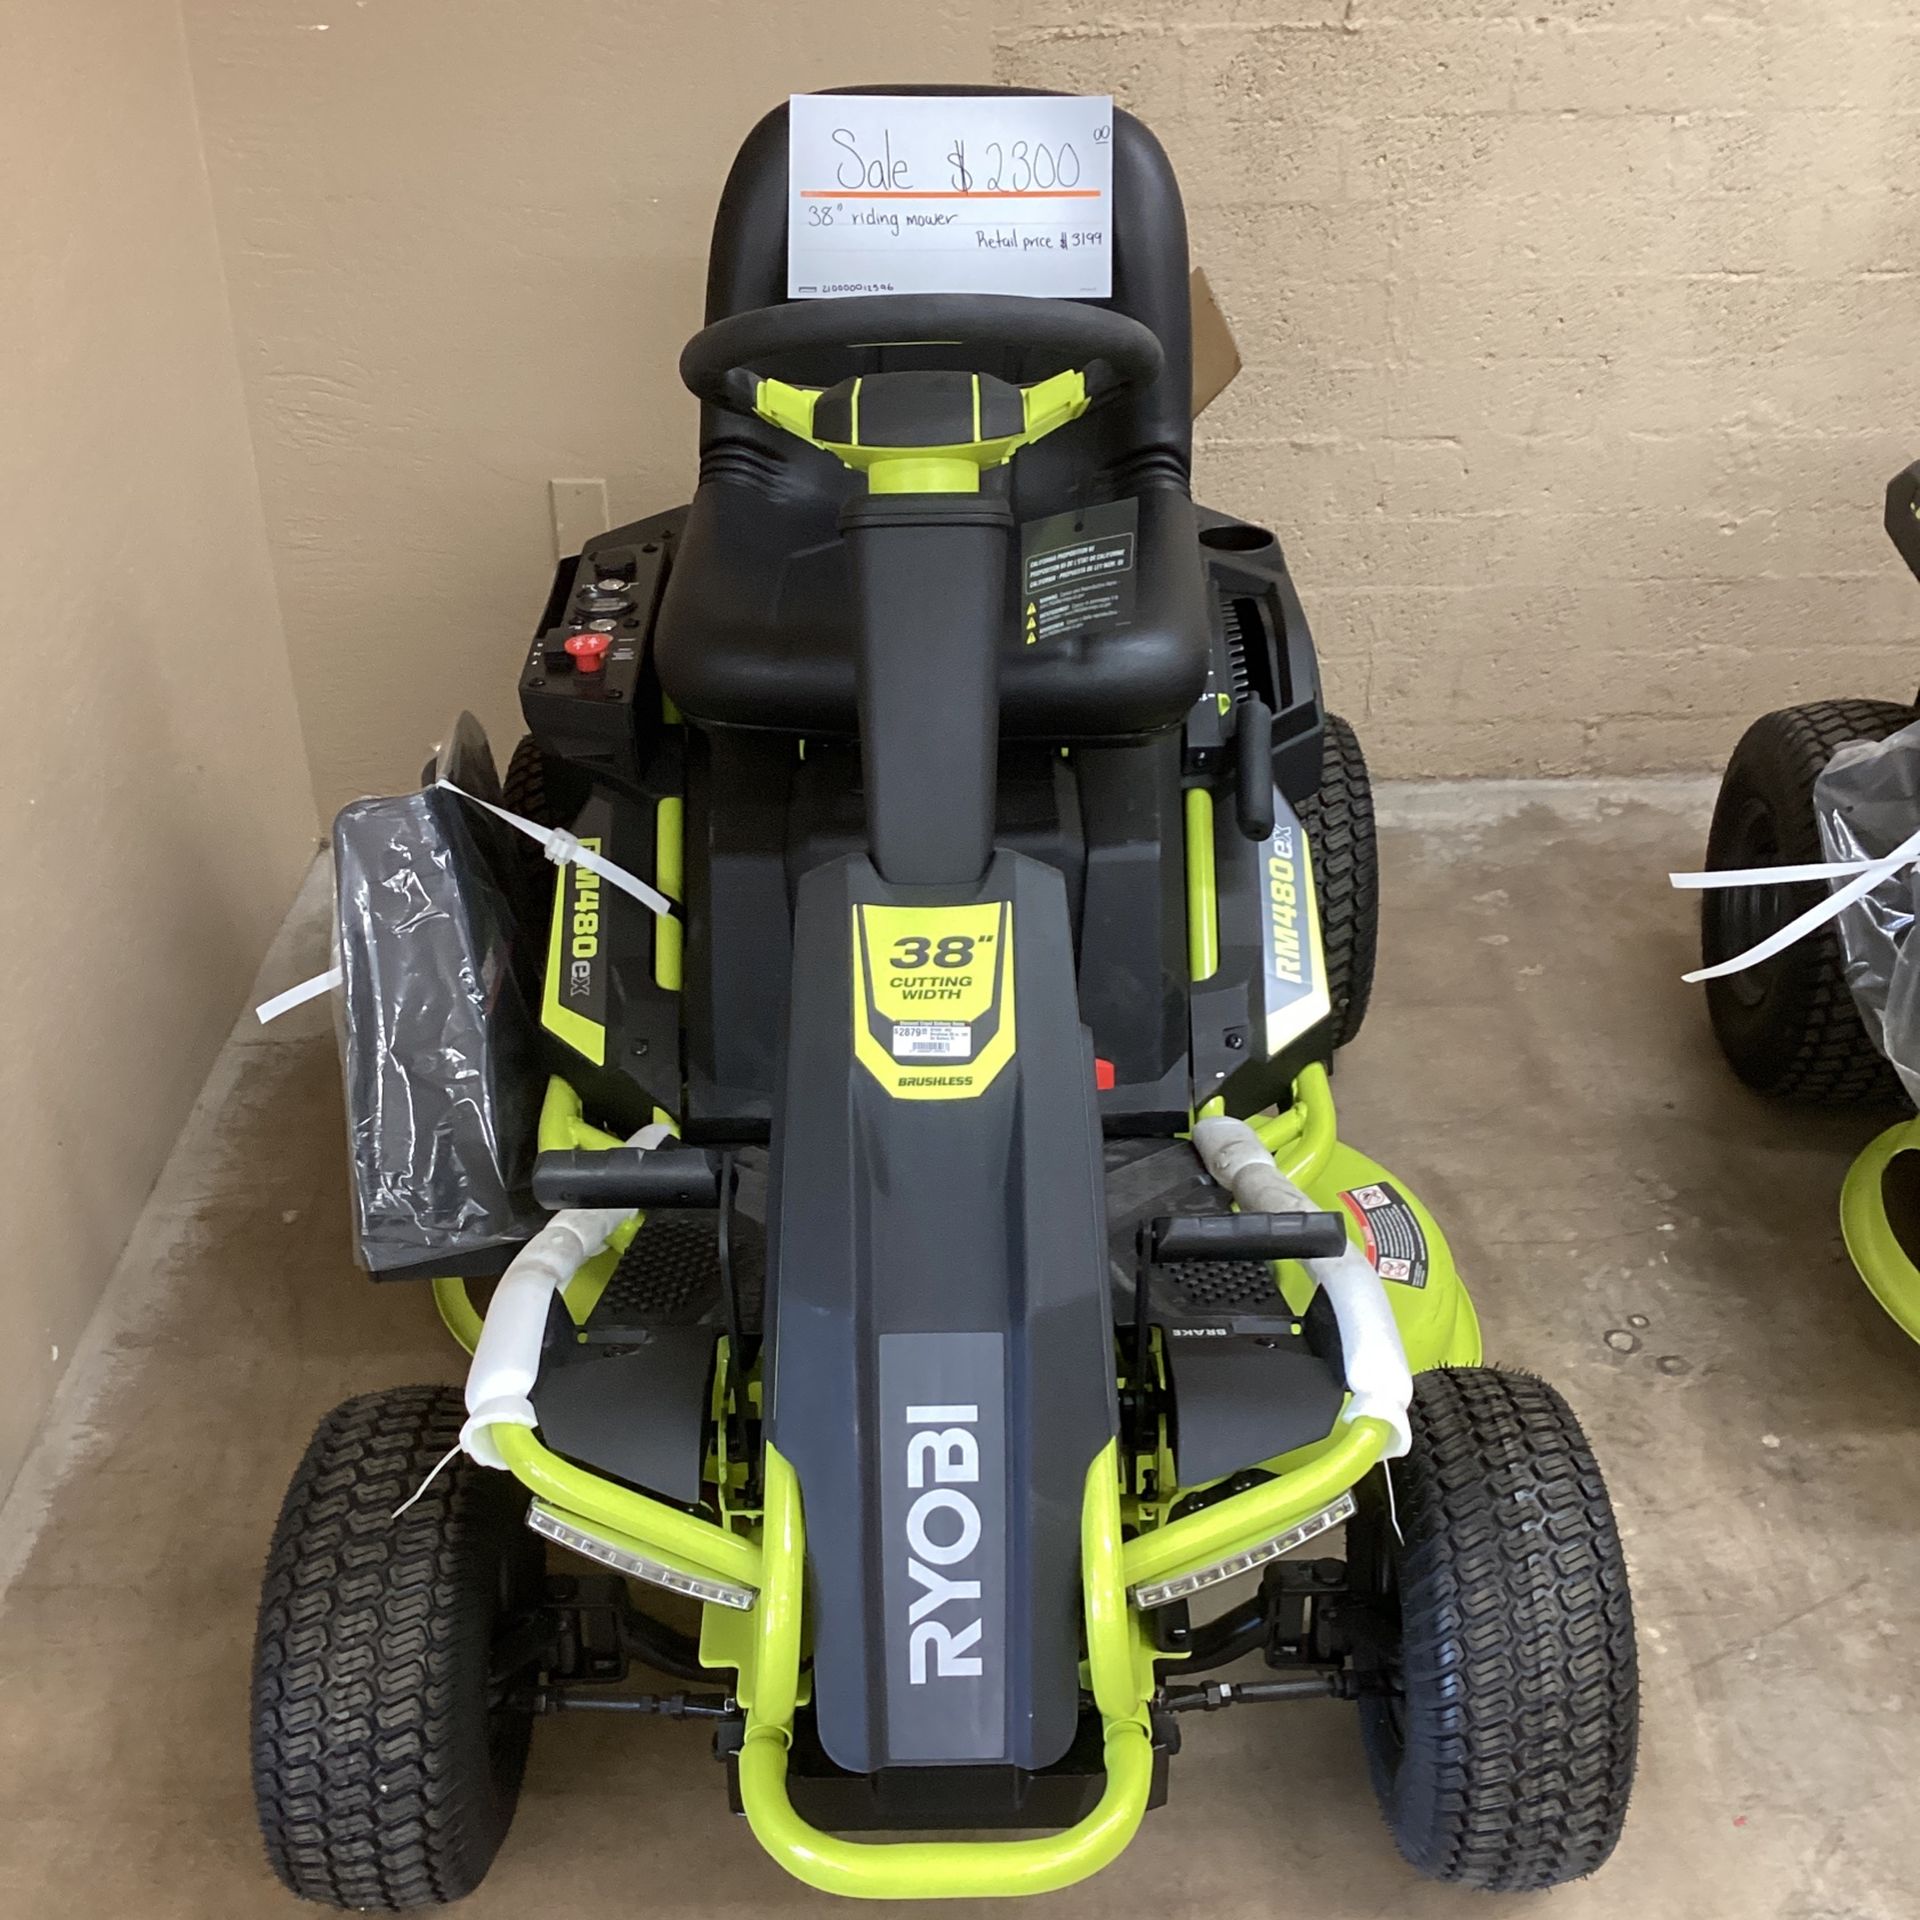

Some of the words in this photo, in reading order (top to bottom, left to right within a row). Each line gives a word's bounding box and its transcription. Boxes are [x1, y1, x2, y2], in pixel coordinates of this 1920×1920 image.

[831, 128, 914, 190] Sale
[852, 207, 899, 236] riding
[906, 213, 958, 227] mower
[976, 228, 1018, 249] Retail
[1023, 236, 1054, 251] price
[889, 934, 994, 970] 38"
[889, 976, 973, 988] CUTTING
[902, 989, 962, 1000] WIDTH
[898, 1076, 974, 1087] BRUSHLESS
[1172, 1328, 1227, 1337] BRAKE
[906, 1404, 983, 1685] RYOBI
